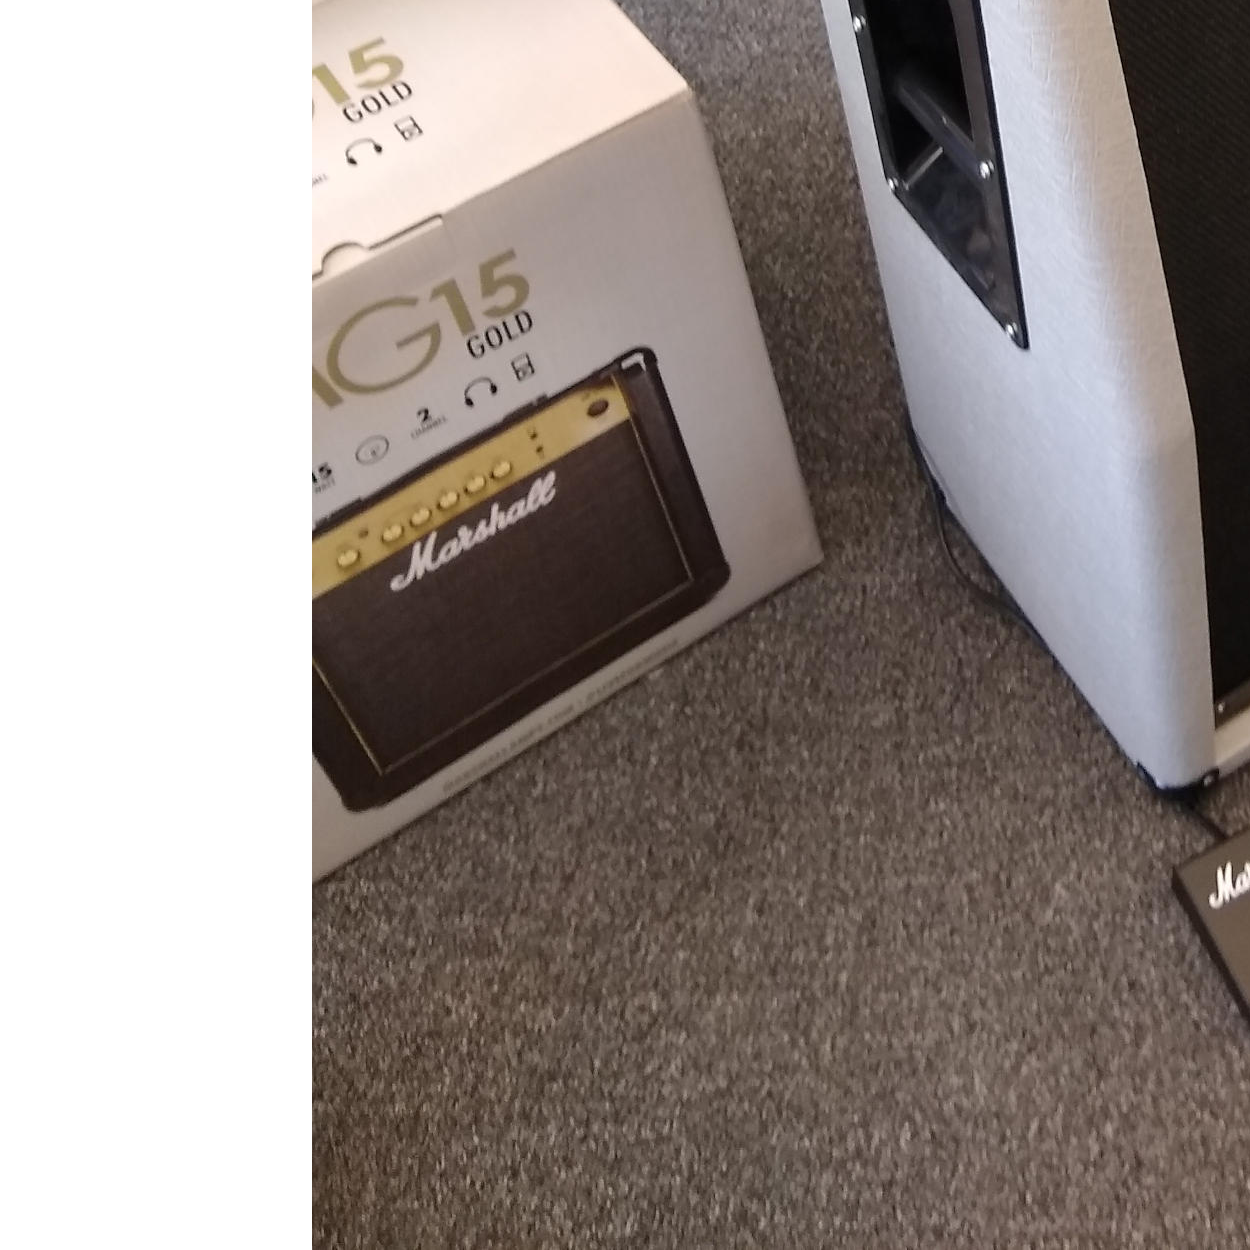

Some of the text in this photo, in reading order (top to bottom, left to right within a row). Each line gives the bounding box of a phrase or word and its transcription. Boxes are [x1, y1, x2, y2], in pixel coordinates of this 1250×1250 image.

[342, 81, 413, 123] GOLD
[466, 310, 533, 359] GOLD
[391, 472, 556, 591] Marshall
